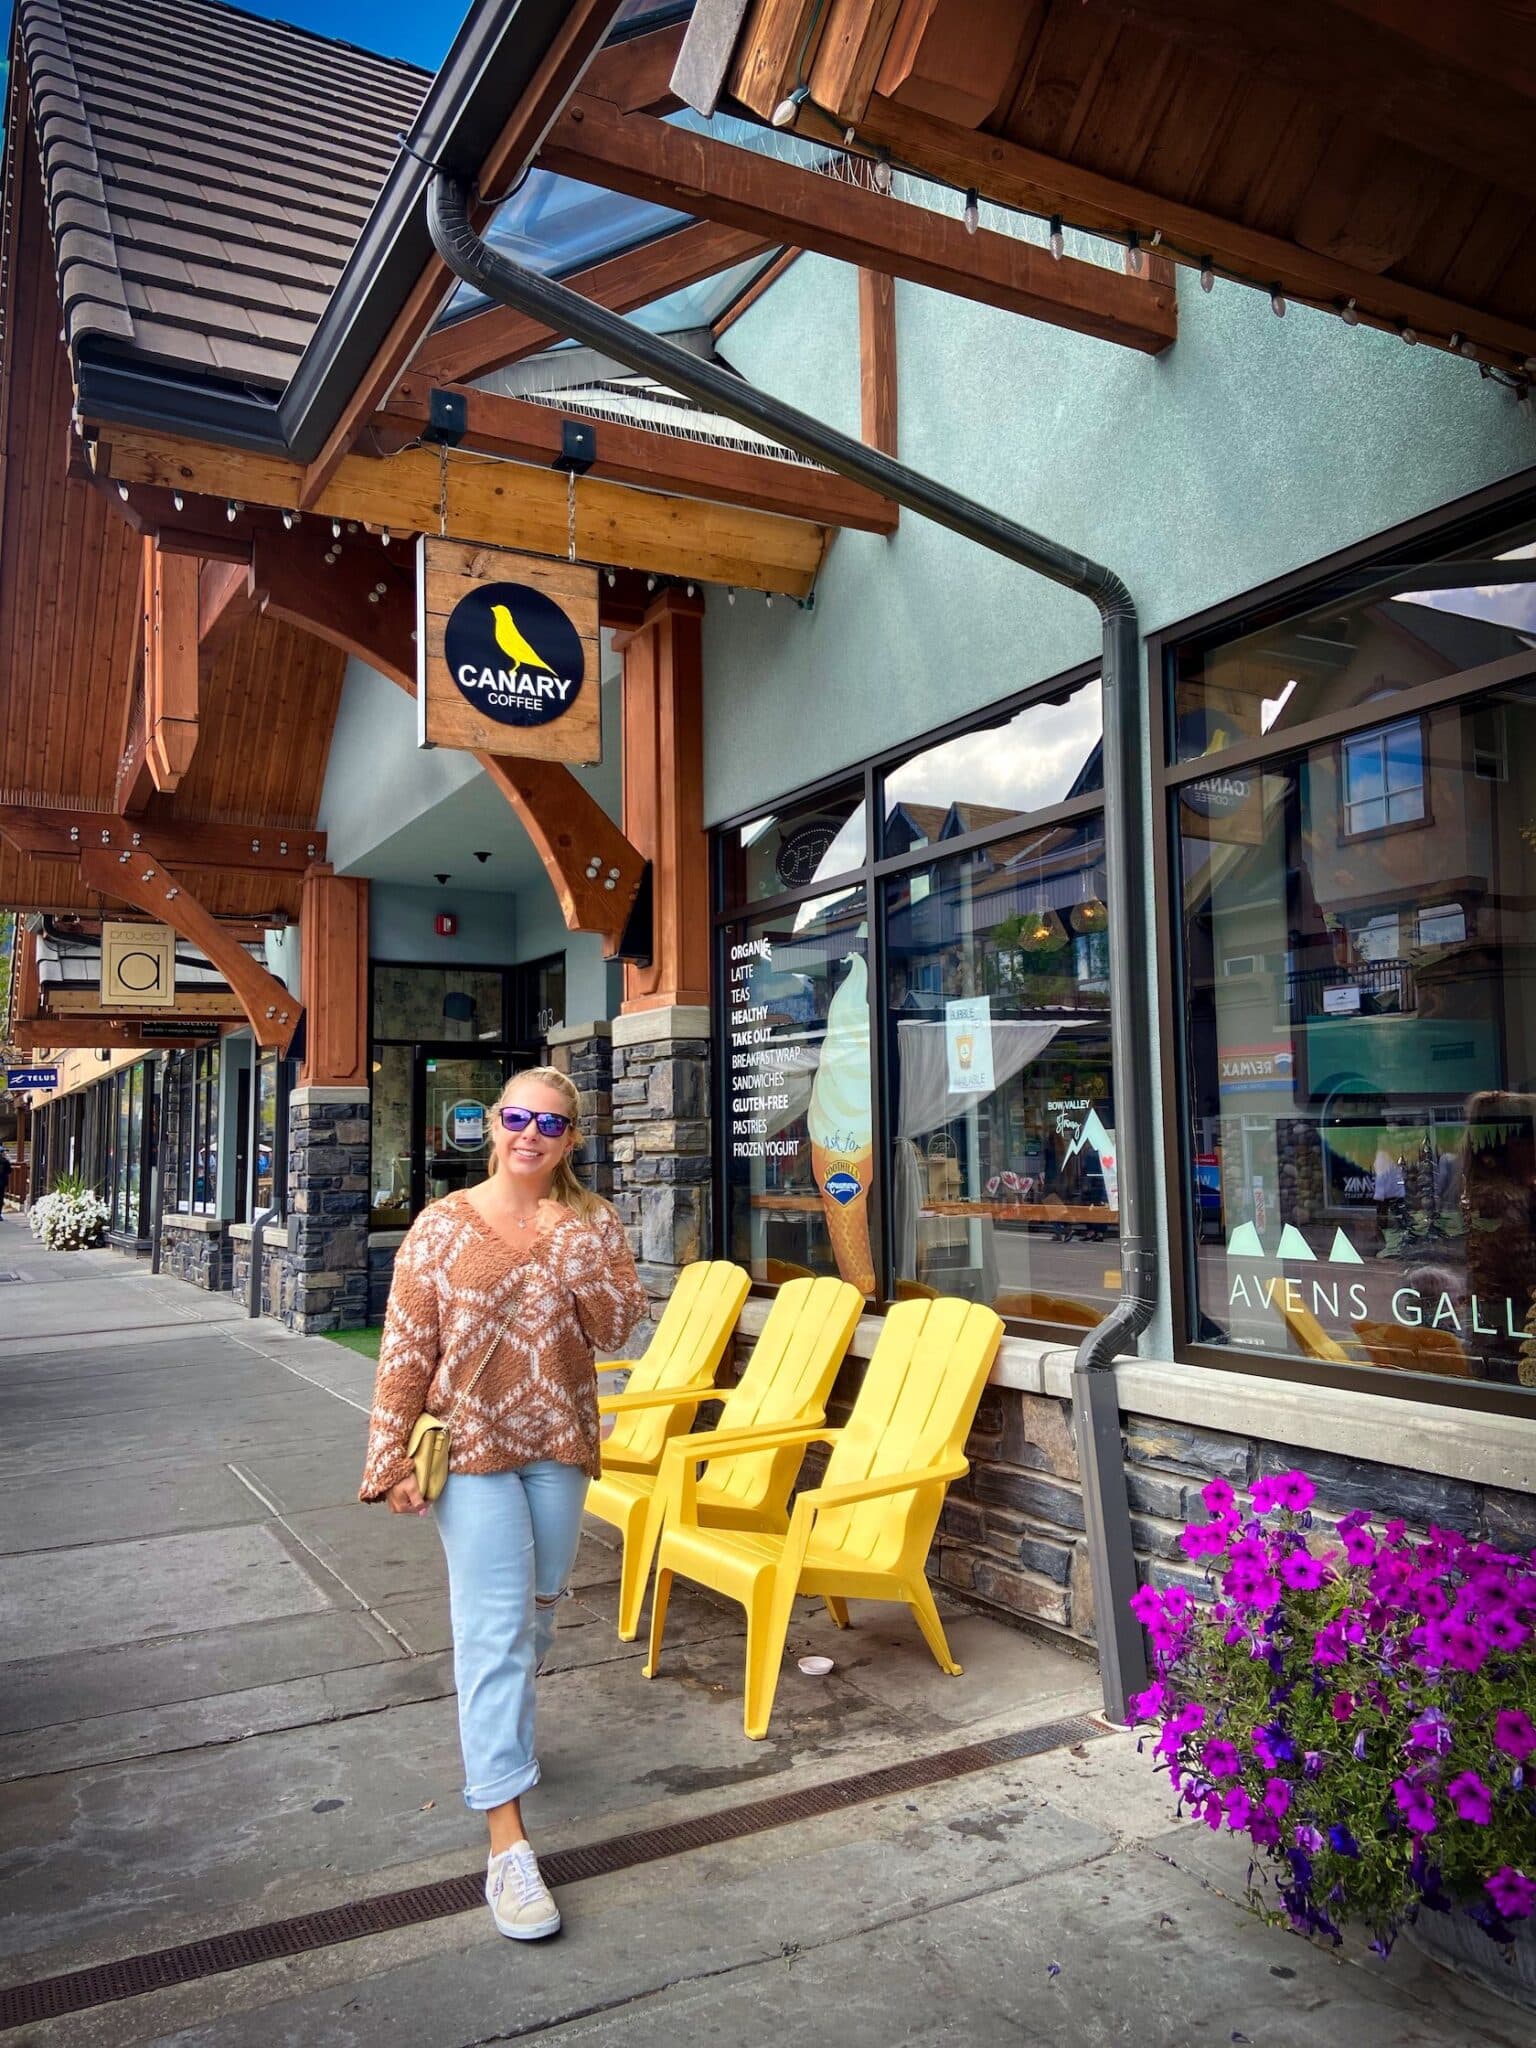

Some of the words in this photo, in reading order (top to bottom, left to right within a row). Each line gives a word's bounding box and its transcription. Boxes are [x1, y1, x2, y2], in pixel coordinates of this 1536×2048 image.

[458, 664, 571, 700] CANARY
[488, 692, 543, 711] COFFEE
[731, 964, 754, 982] LATTE
[731, 986, 751, 1003] TEAS
[537, 1008, 554, 1031] 103
[731, 1005, 769, 1025] HEALTHY
[731, 1030, 753, 1047] TAKE
[753, 1027, 772, 1043] OUT
[732, 1049, 775, 1069] BREAKFAST
[775, 1046, 801, 1062] WRAP
[28, 1074, 56, 1082] TELUS
[732, 1071, 785, 1091] SANDWICHES
[732, 1094, 789, 1113] GLUTEN-FREE
[1047, 1101, 1064, 1111] BOW
[1064, 1099, 1090, 1110] VALLEY
[733, 1119, 768, 1136] PASTRIES
[733, 1142, 764, 1158] FROZEN
[765, 1140, 800, 1156] YOGURT
[1229, 1273, 1368, 1321] AVENS
